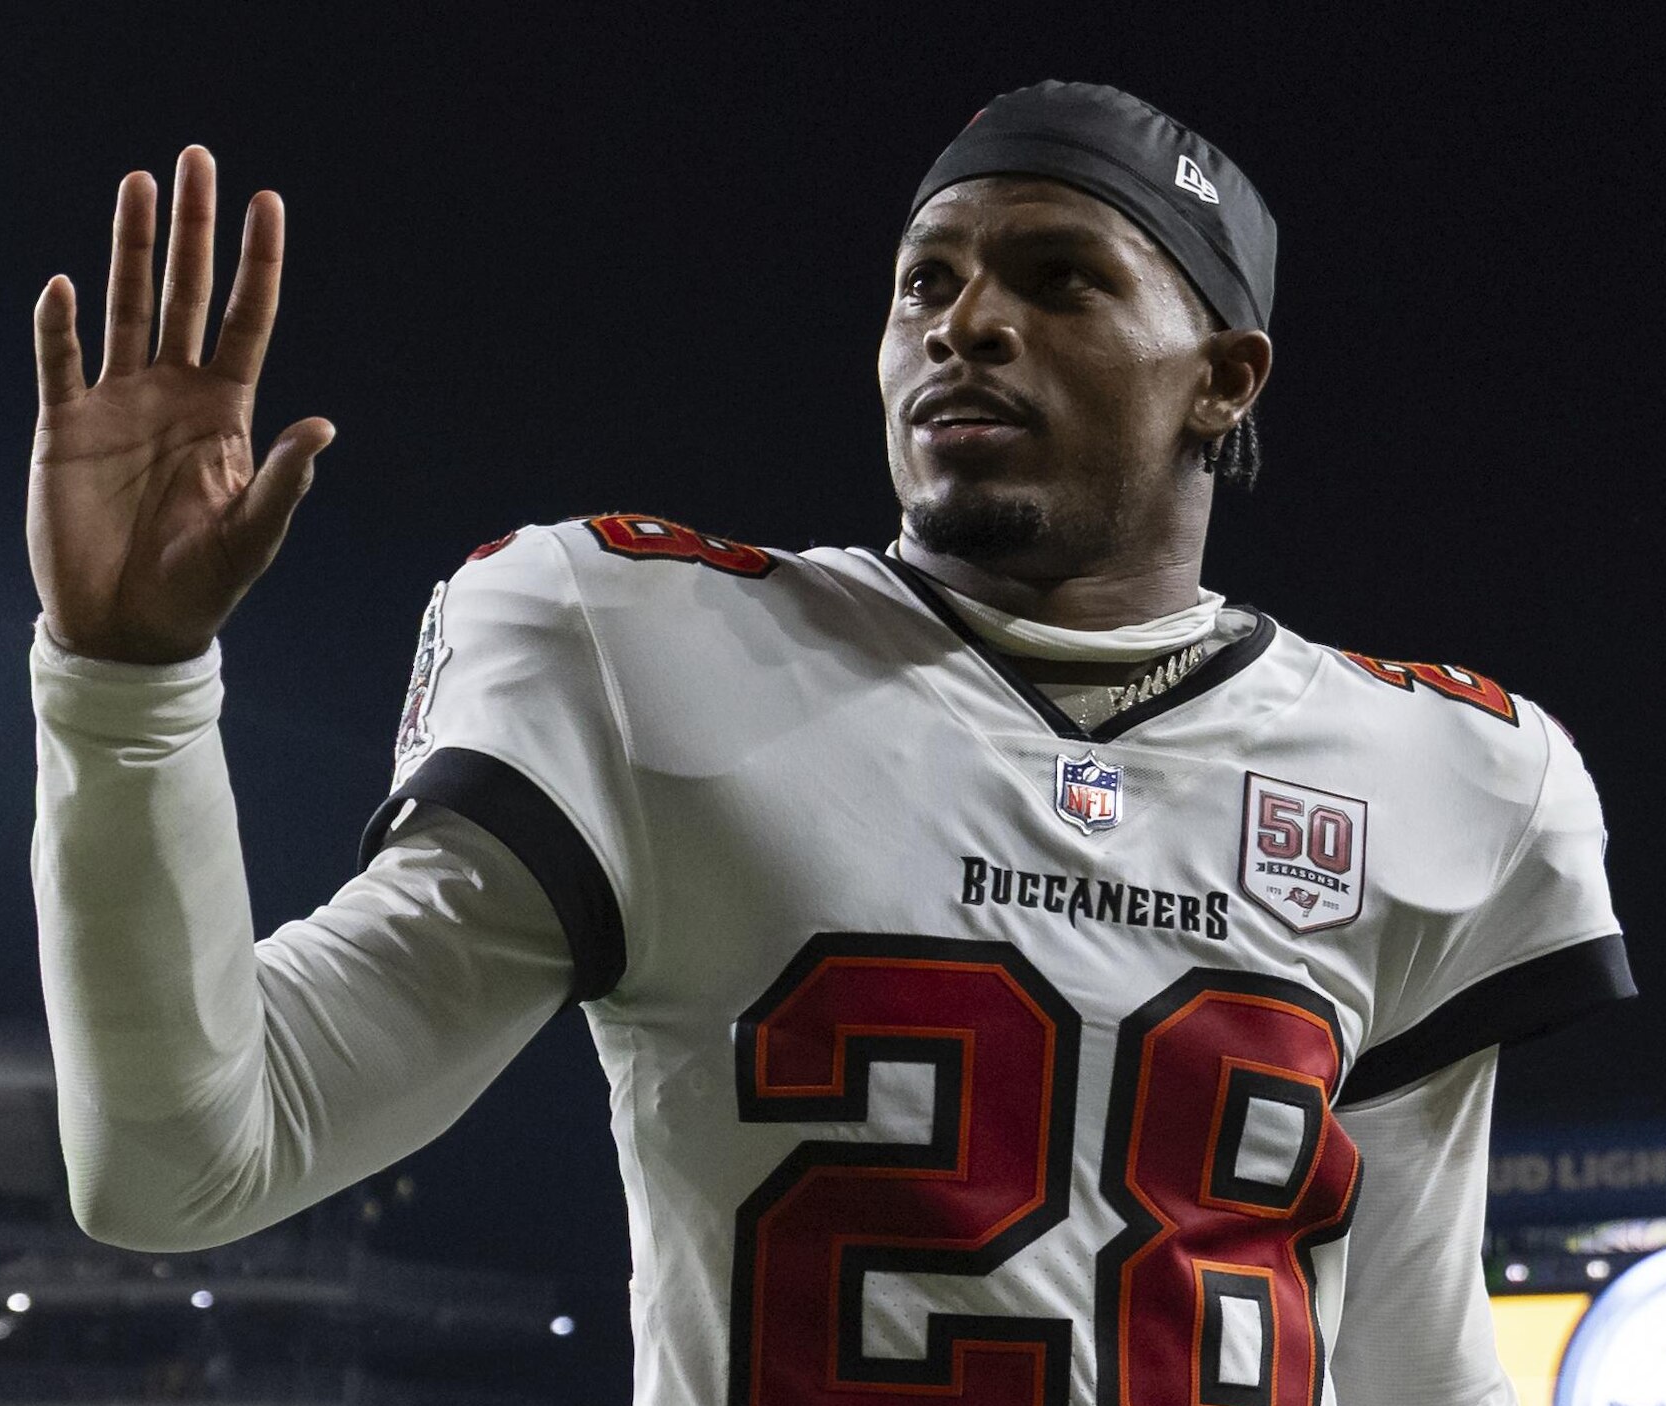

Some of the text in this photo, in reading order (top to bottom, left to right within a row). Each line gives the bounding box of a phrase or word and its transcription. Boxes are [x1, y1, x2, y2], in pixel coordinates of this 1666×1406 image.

[1066, 784, 1112, 819] NFL
[1257, 790, 1353, 876] 50
[1271, 863, 1335, 888] SEASONS
[960, 855, 1229, 941] BUCCANEERS
[1489, 1152, 1551, 1195] UD
